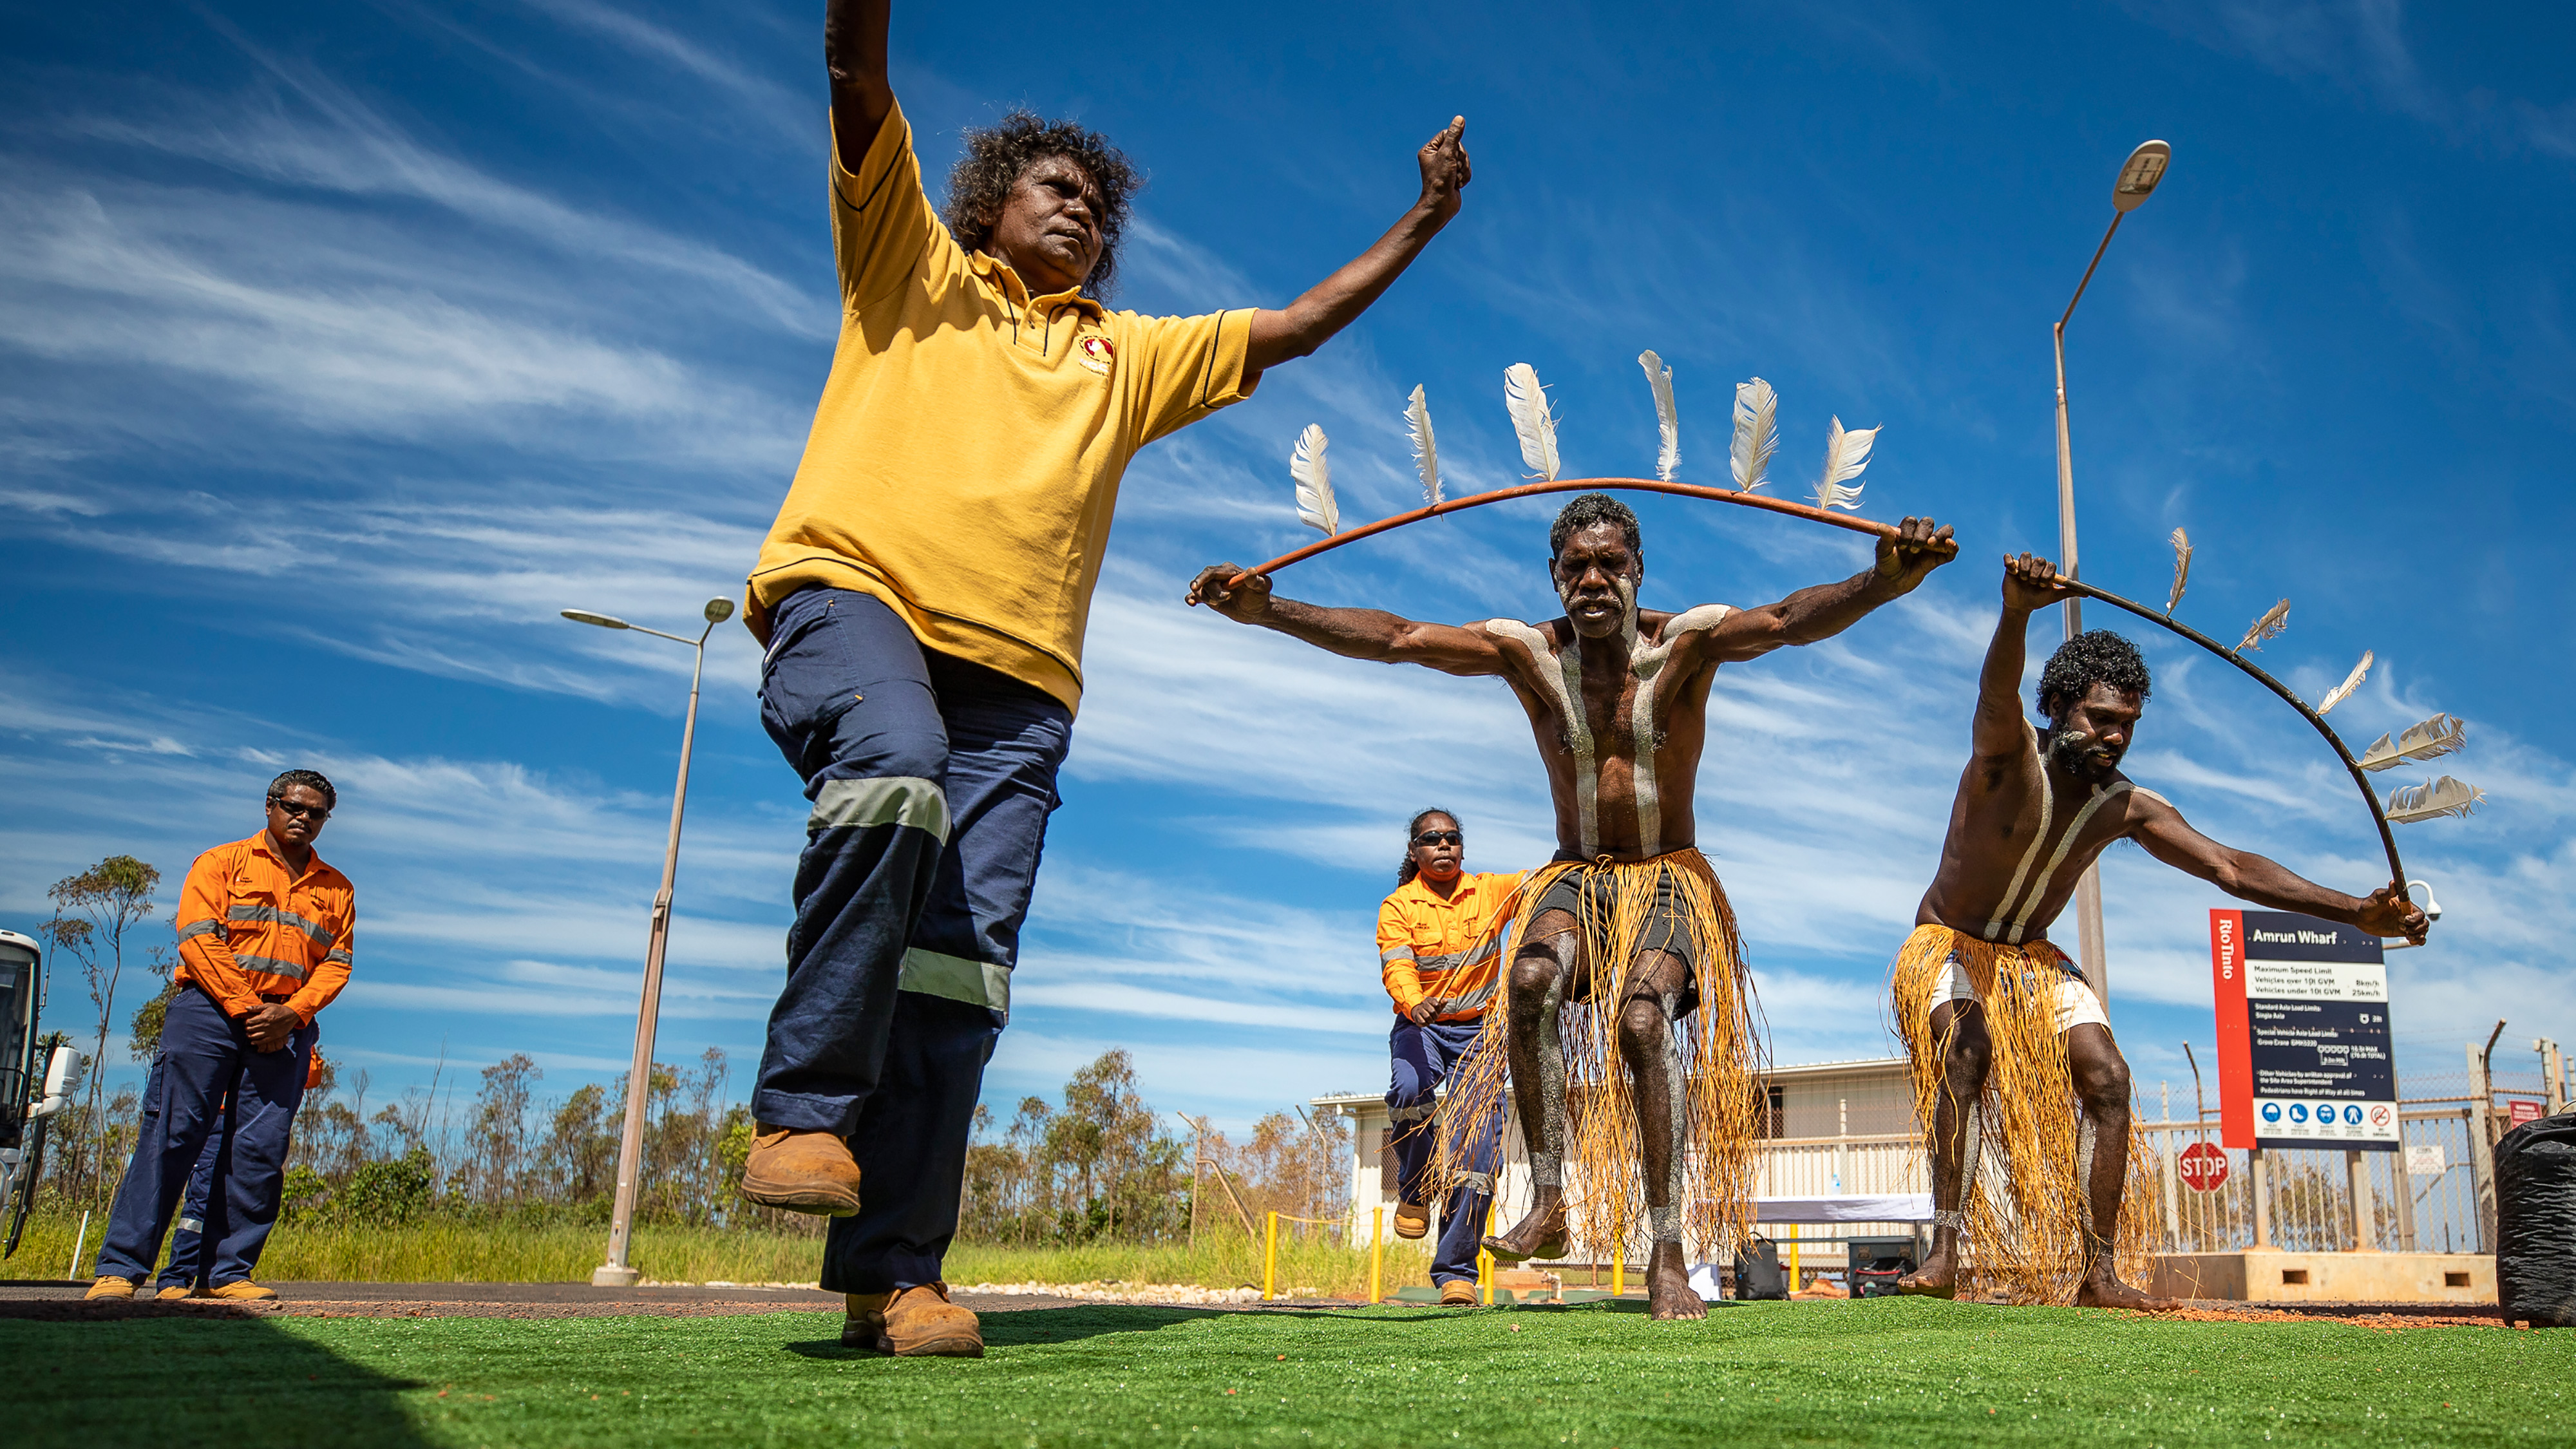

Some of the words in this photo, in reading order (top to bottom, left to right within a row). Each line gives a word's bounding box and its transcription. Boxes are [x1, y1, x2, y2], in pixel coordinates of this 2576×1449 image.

[2253, 928, 2296, 943] Amrun
[2297, 929, 2338, 945] Wharf
[2290, 967, 2313, 975] Speed
[2255, 976, 2284, 985] Vehicles
[2318, 978, 2335, 986] GVM
[2255, 986, 2285, 994] Vehicles
[2324, 987, 2341, 996] GVM
[2182, 1157, 2226, 1177] STOP
